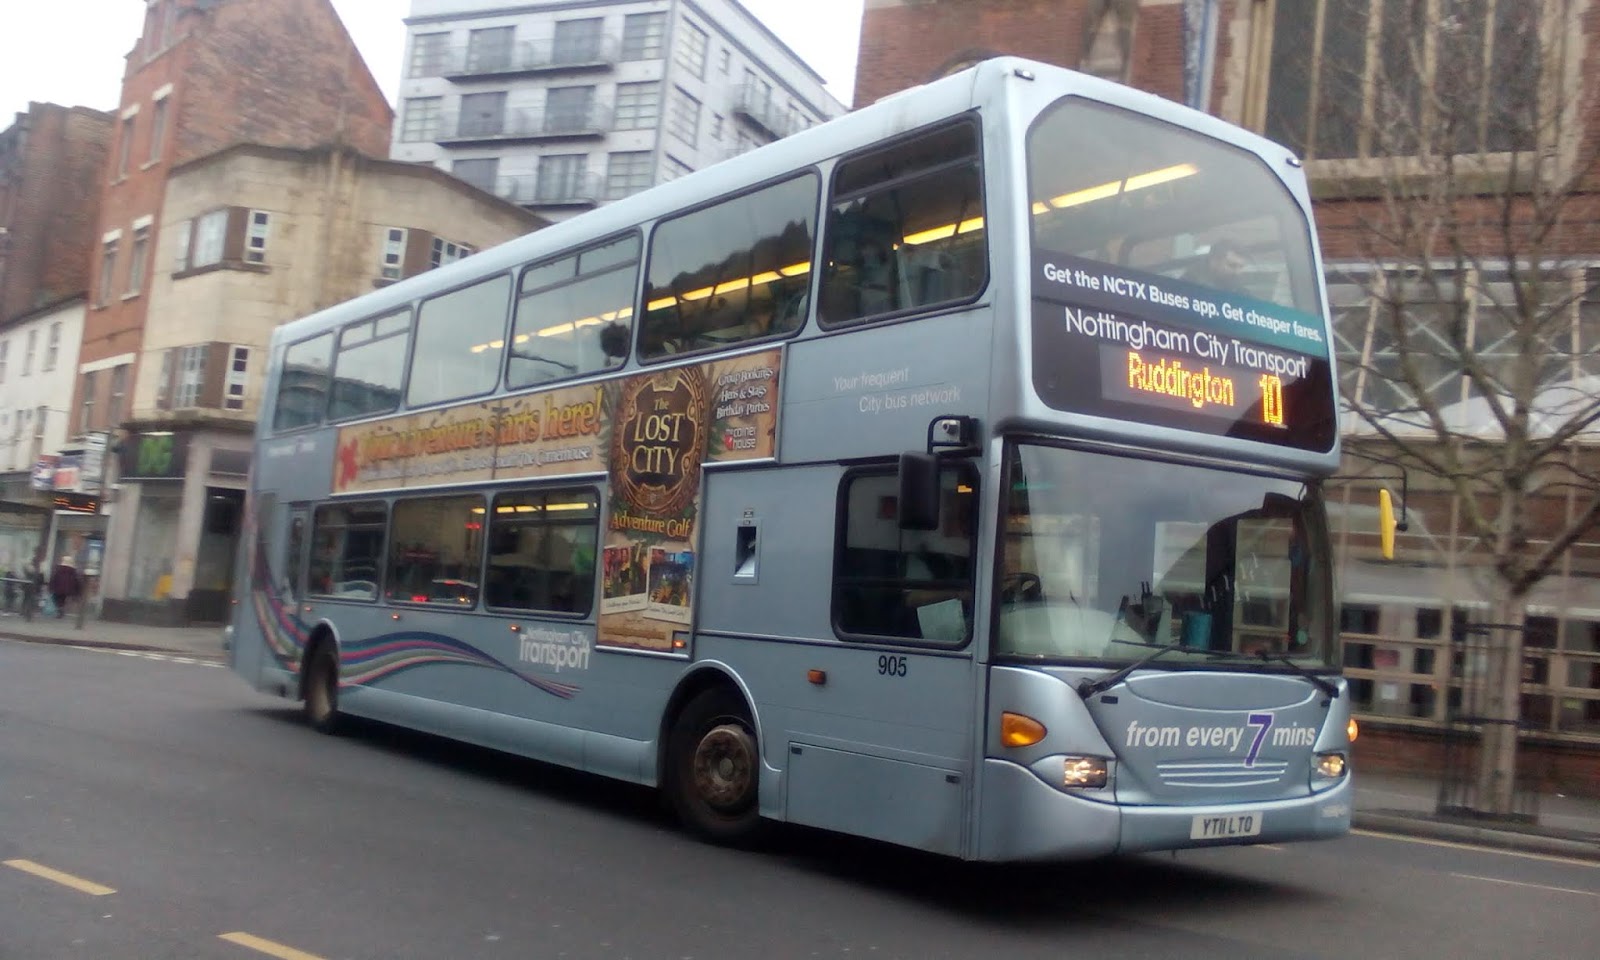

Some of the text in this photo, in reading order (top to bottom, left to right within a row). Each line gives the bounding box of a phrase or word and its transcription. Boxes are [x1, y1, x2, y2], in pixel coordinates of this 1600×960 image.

[1043, 262, 1322, 343] Get the NCTX Buses app. Get cheaper fares.
[1065, 306, 1307, 379] Nottingham City Transport
[718, 367, 774, 386] Group Bookings
[833, 367, 910, 392] Your frequent
[1127, 352, 1284, 425] Ruddington 10
[653, 397, 669, 411] The
[721, 389, 739, 402] Hens
[747, 384, 768, 398] Stags
[859, 386, 961, 415] City bus network
[542, 384, 604, 442] here!
[716, 401, 770, 420] Birthday Parties
[634, 411, 685, 443] LOST
[733, 438, 756, 450] house
[632, 444, 681, 476] CITY
[611, 510, 691, 538] Adventure Golf
[519, 633, 591, 673] Transport
[878, 655, 907, 677] 905
[1126, 712, 1316, 769] from every 7 mins
[1203, 815, 1253, 836] YT11 LTO
